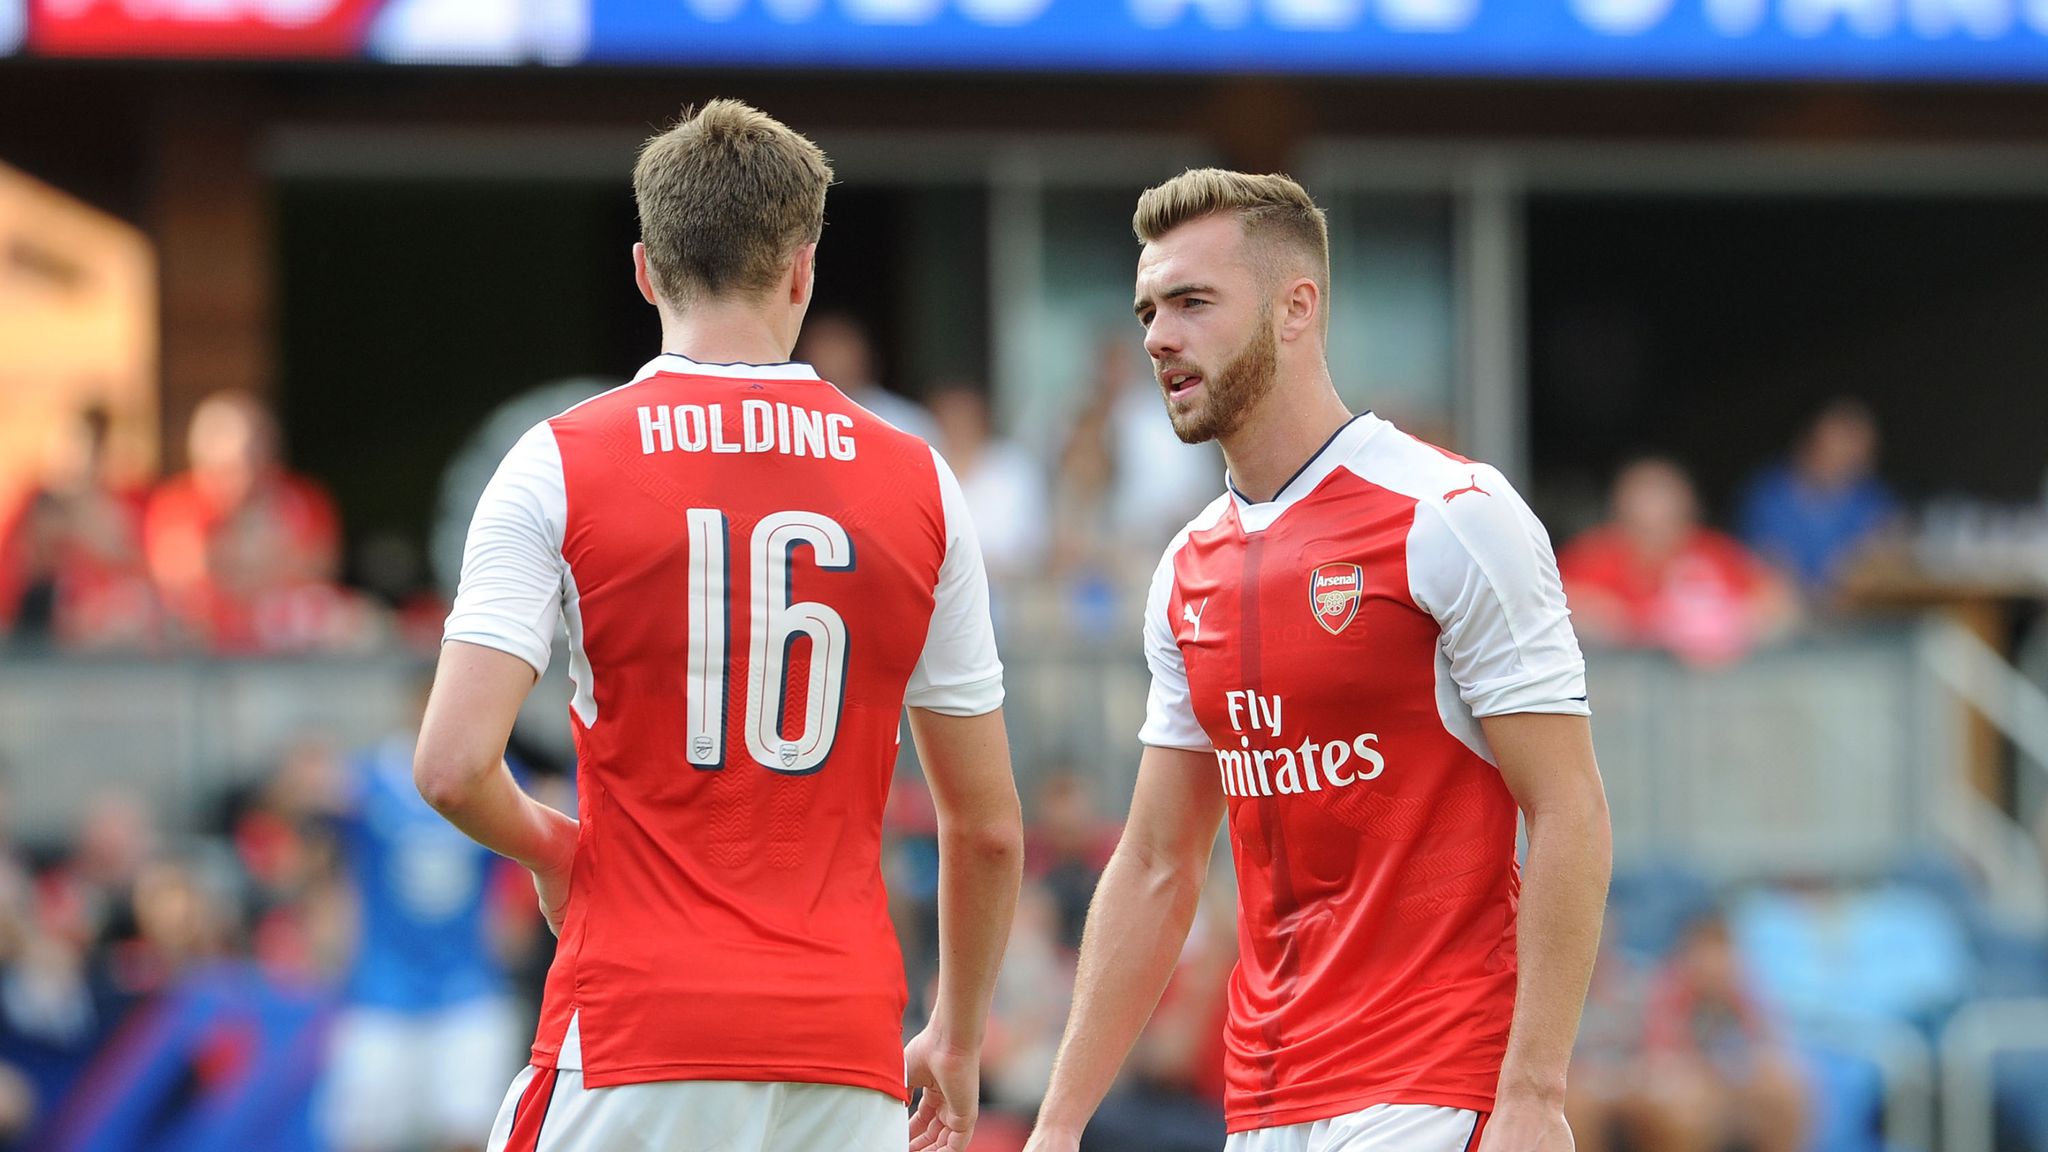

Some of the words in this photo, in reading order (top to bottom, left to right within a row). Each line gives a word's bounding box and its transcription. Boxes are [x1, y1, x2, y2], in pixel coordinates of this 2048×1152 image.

[637, 399, 856, 461] HOLDING
[1316, 572, 1356, 587] Arsenal
[686, 508, 855, 774] 16
[1226, 689, 1282, 737] Fly
[1215, 733, 1385, 797] mirates
